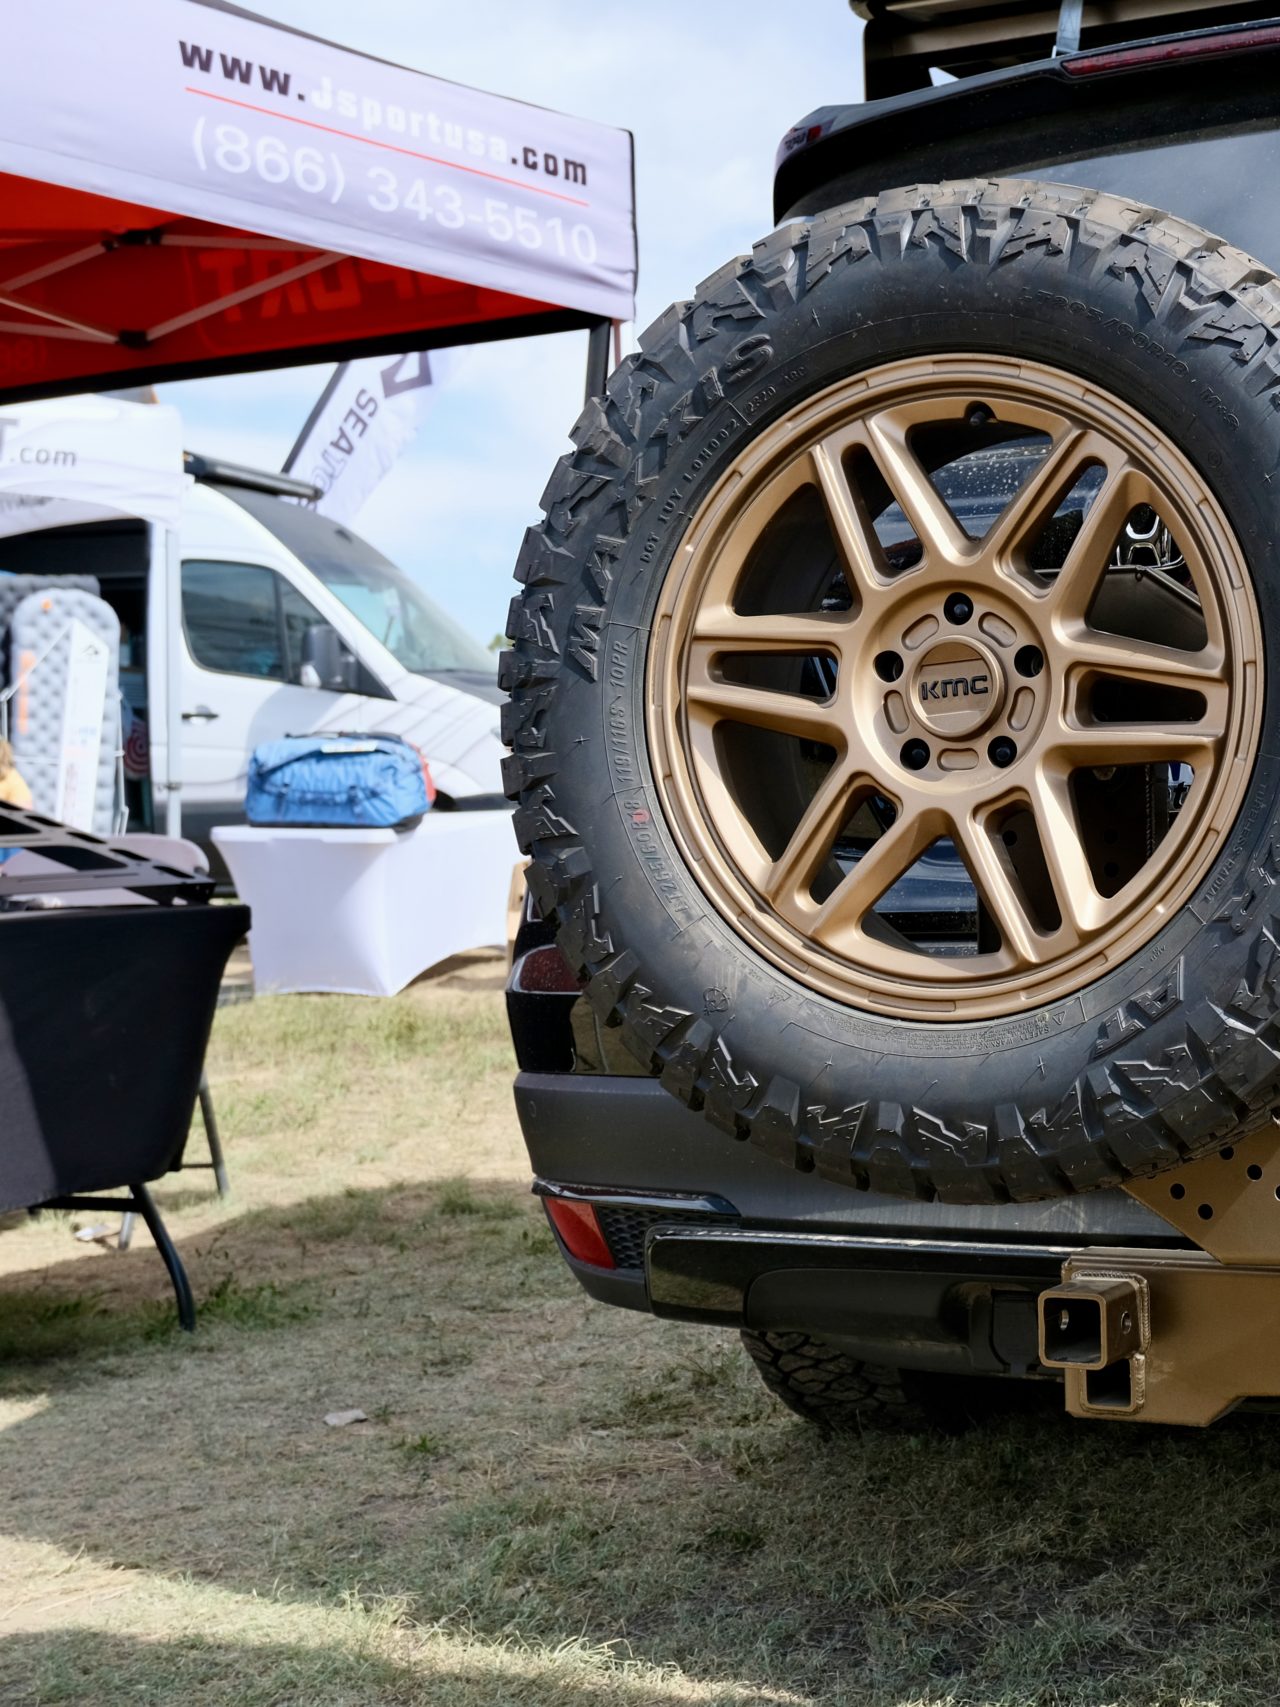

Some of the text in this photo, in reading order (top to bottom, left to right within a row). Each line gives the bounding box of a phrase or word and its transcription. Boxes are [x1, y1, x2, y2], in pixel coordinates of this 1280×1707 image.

[178, 40, 588, 187] www.Jsportusa.com
[192, 116, 598, 265] (866) 343-5510
[921, 675, 988, 700] KMC
